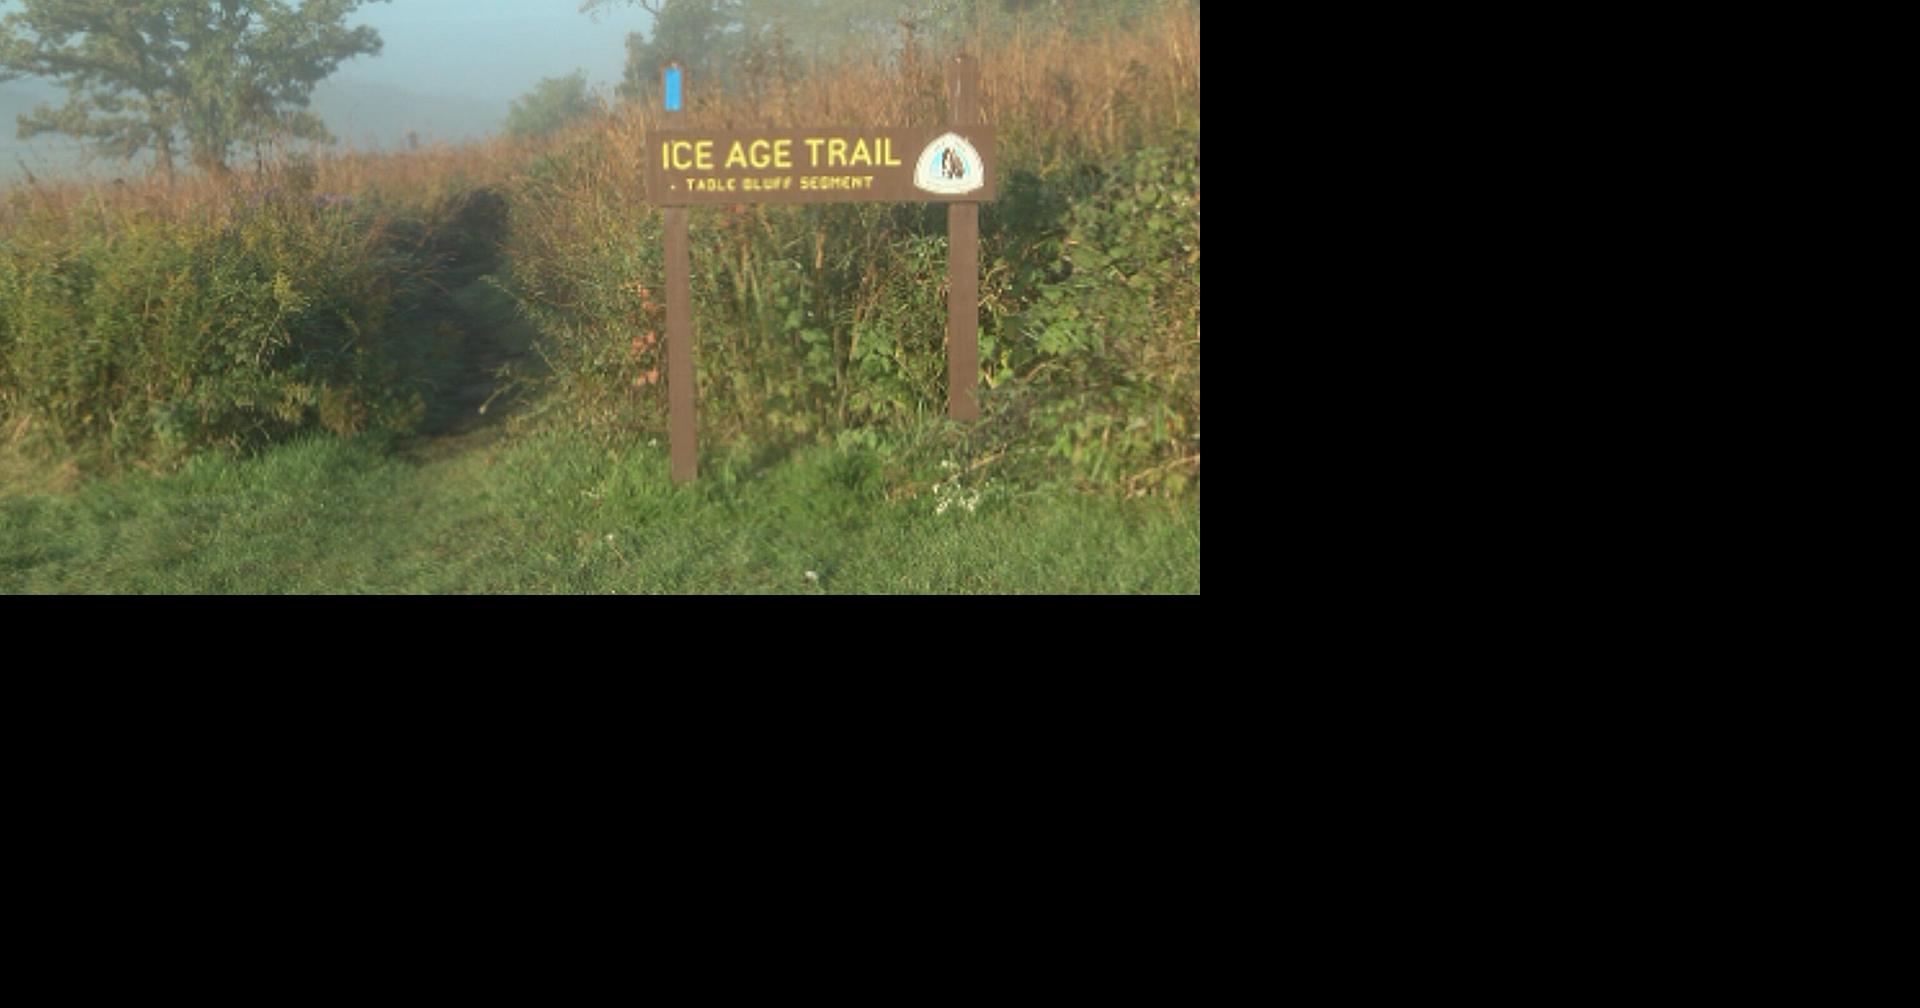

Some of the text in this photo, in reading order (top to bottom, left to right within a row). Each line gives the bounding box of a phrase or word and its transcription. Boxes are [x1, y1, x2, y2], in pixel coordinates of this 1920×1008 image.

[661, 137, 902, 170] ICE AGE TRAIL
[686, 174, 874, 192] TABLE BLUFF SEGMENT
